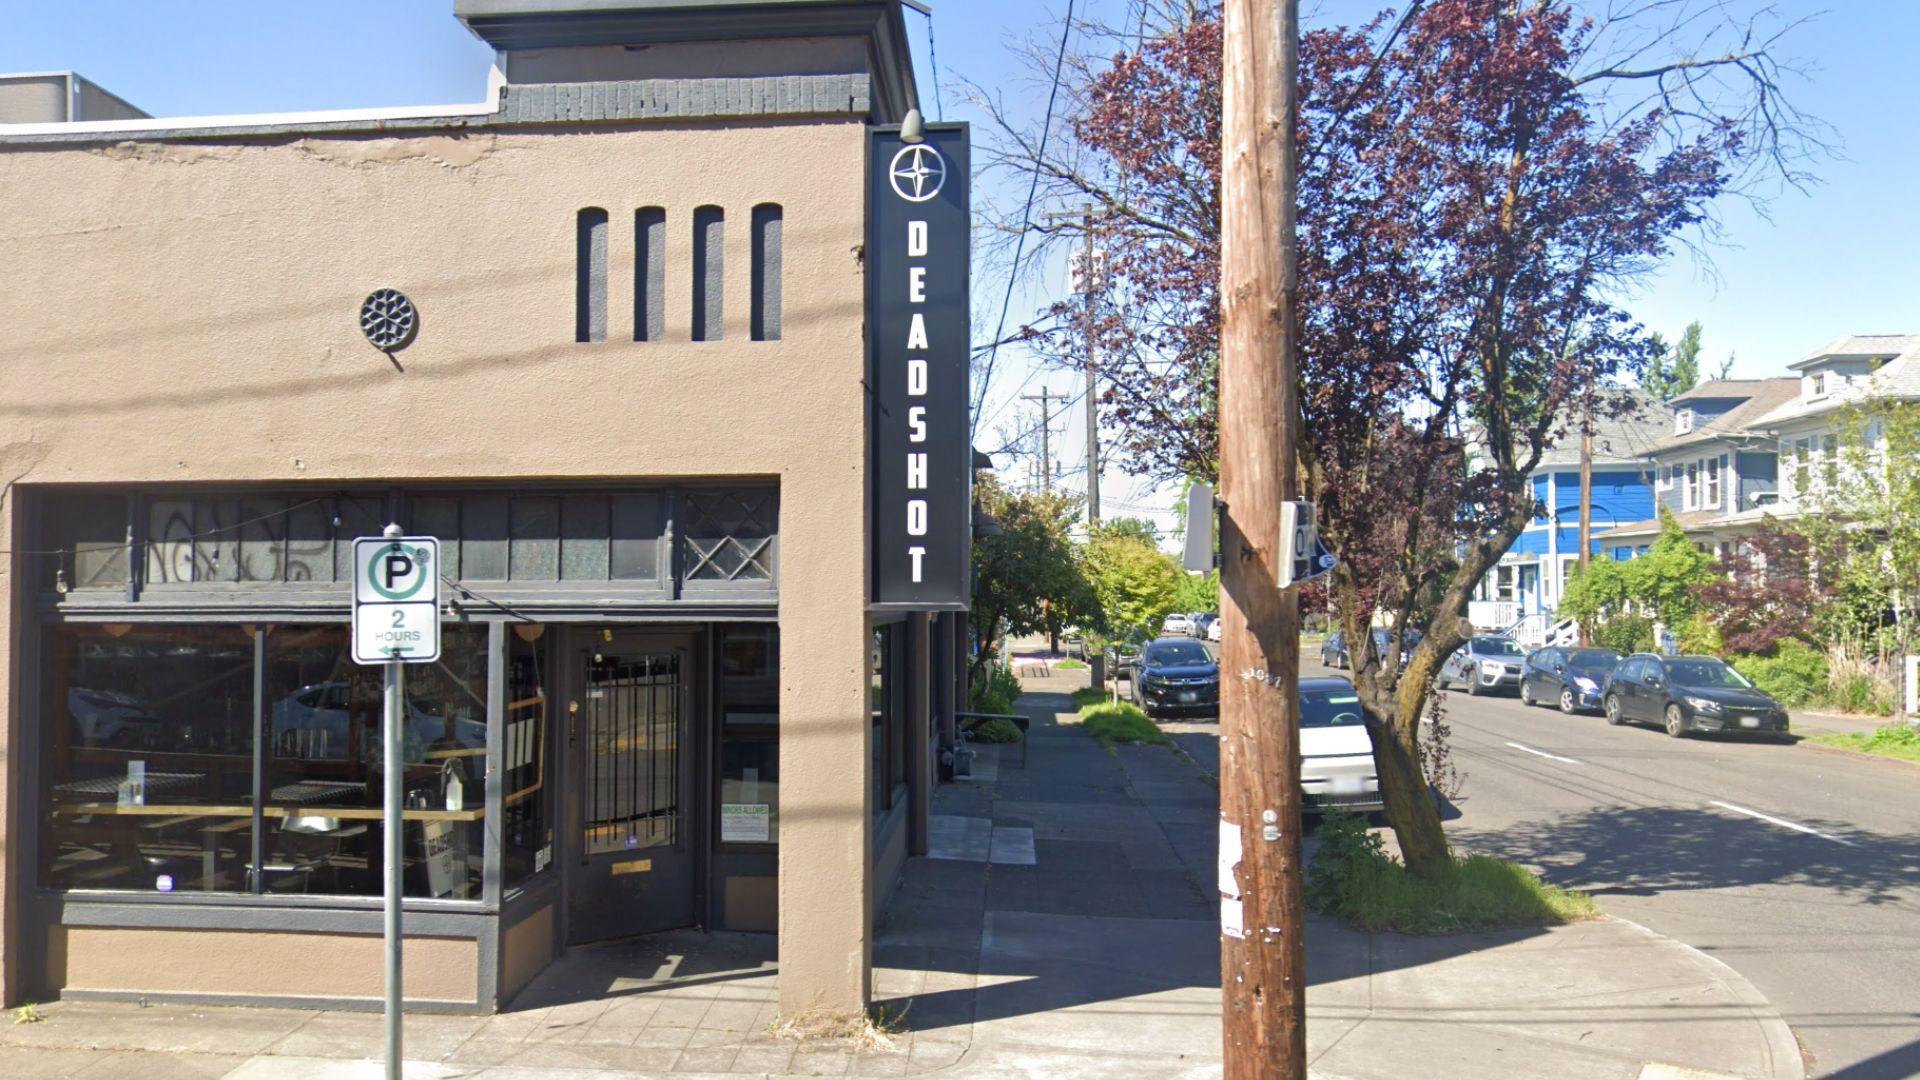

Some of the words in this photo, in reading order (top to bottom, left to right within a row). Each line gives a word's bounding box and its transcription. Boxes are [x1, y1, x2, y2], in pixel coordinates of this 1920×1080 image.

[907, 220, 929, 583] DEADSHOT
[385, 555, 413, 589] P
[391, 609, 405, 629] 2
[375, 630, 421, 642] HOURS
